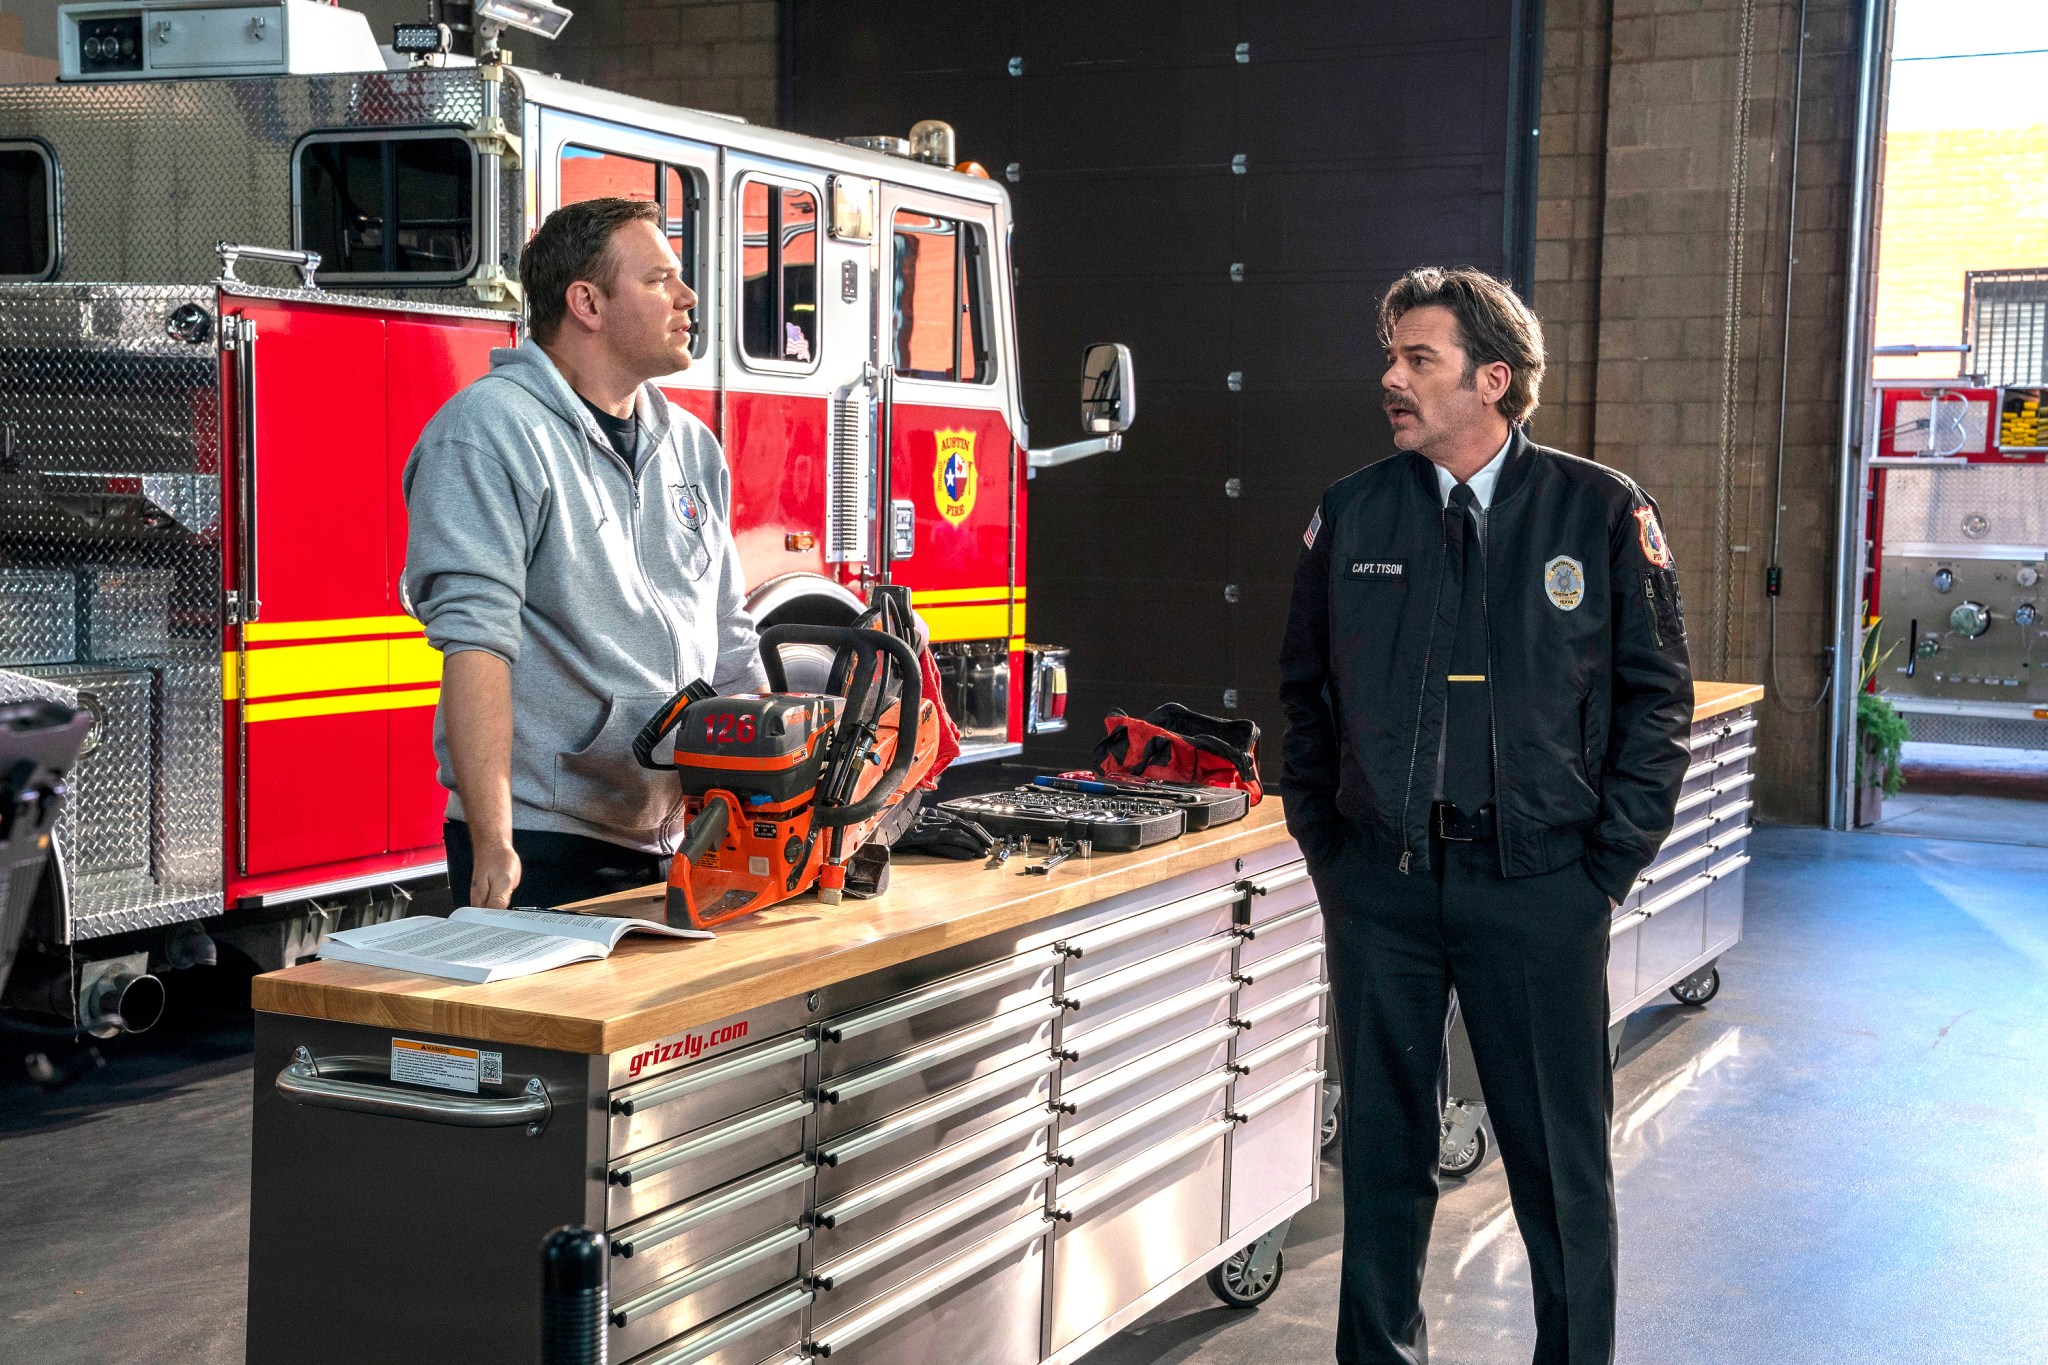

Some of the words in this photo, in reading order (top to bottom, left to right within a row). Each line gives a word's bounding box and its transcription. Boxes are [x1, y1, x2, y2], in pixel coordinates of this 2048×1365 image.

[941, 437, 970, 452] AUSTIN
[946, 504, 965, 517] FIRE
[1352, 563, 1375, 574] CAPT.
[1376, 563, 1403, 575] TYSON
[703, 713, 757, 744] 126
[628, 1020, 749, 1078] grizzly.com
